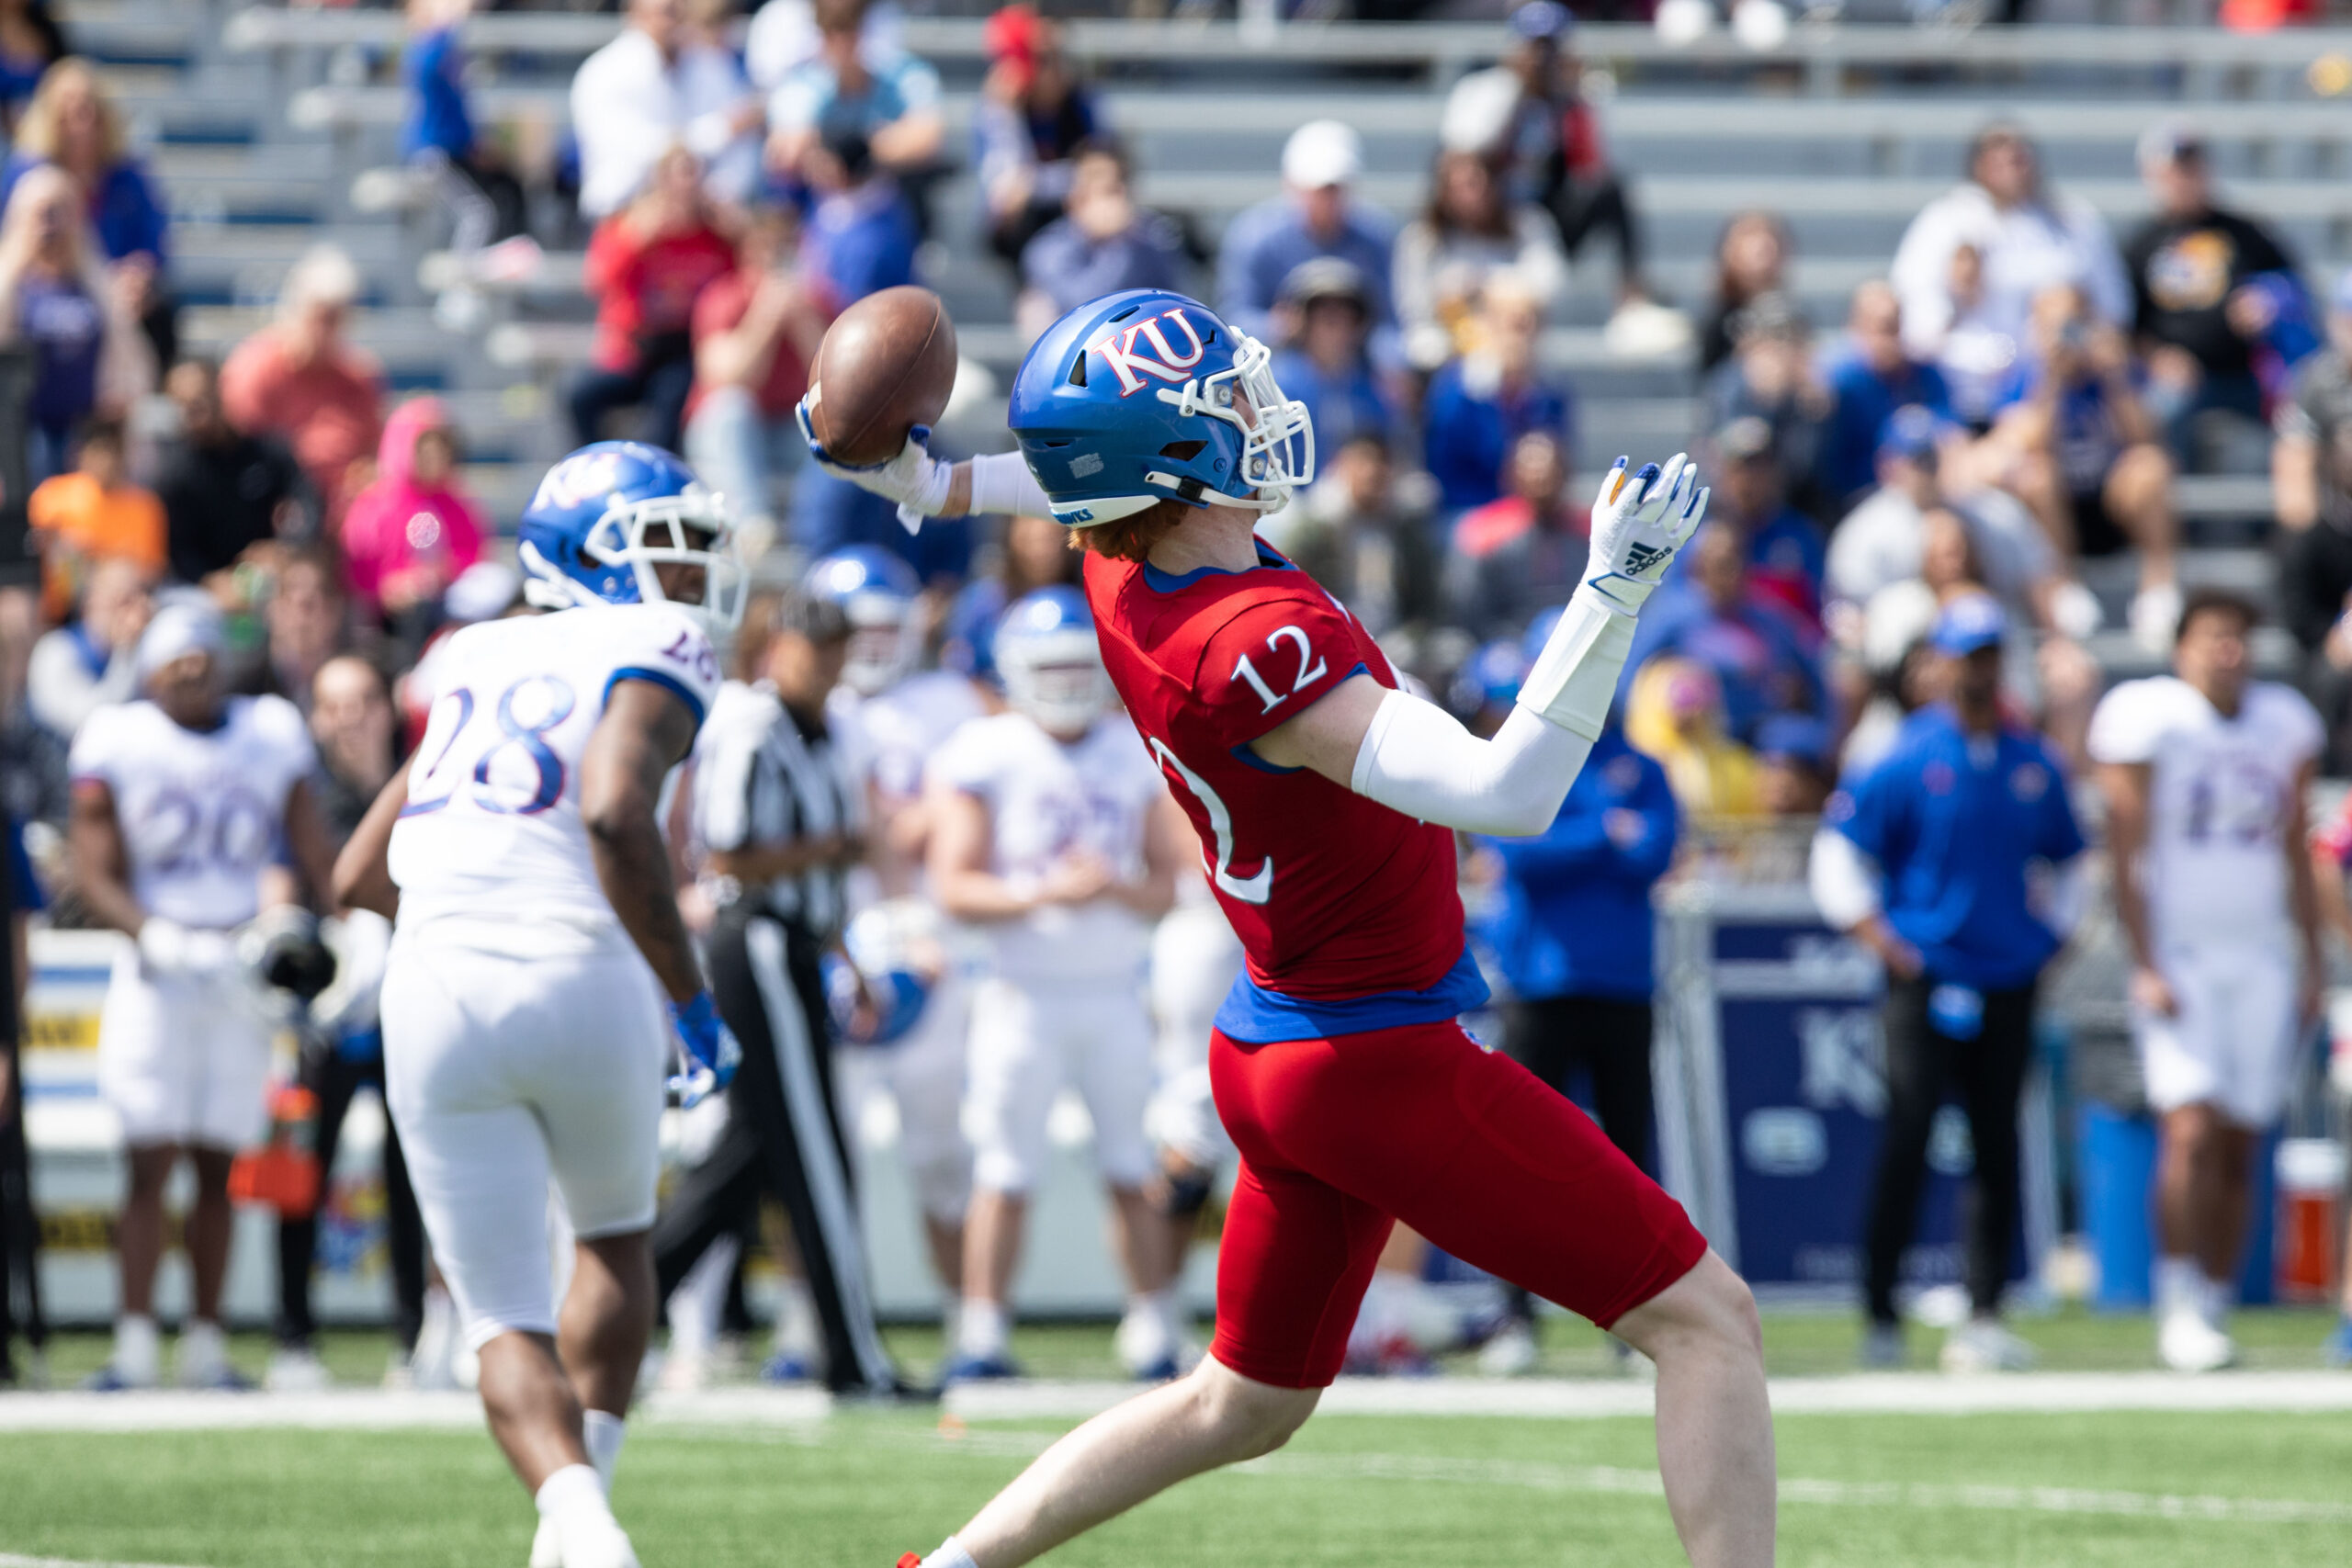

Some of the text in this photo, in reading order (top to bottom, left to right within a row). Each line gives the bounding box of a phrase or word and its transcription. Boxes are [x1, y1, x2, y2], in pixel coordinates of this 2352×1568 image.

[1091, 308, 1204, 398] KU
[1625, 546, 1673, 576] adidas
[1230, 626, 1328, 715] 12
[397, 673, 575, 816] 28
[1149, 736, 1274, 906] 2
